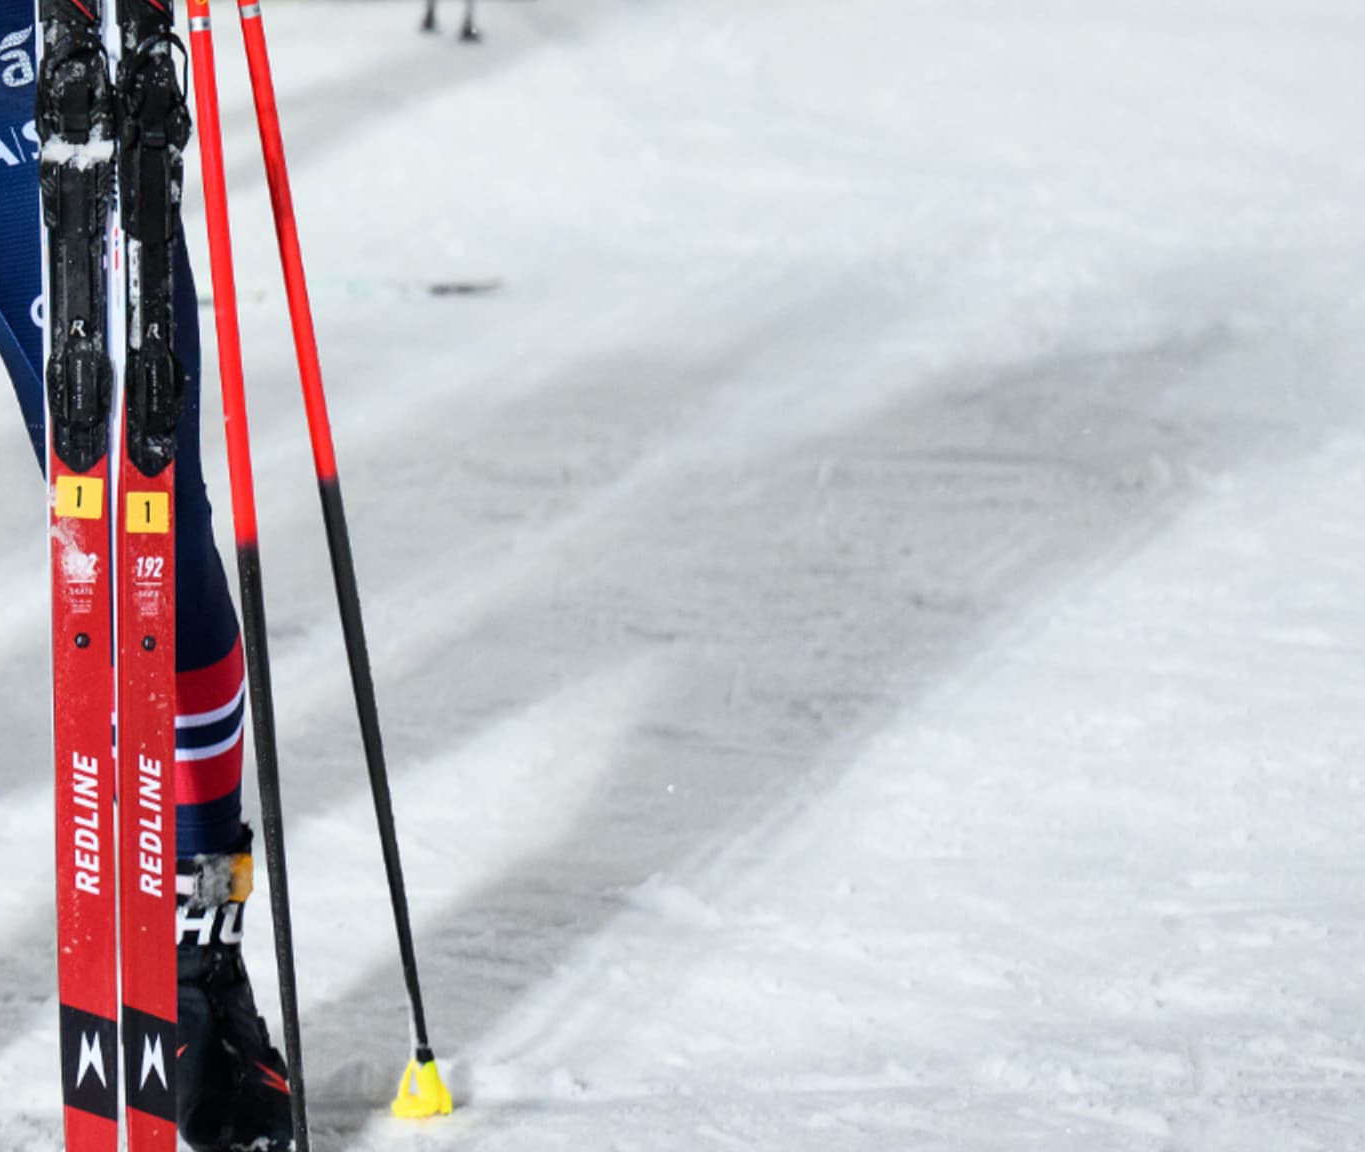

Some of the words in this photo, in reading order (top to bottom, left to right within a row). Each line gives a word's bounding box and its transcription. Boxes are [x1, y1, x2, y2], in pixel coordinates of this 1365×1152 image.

[76, 485, 83, 509] 1
[144, 501, 151, 524] 1
[135, 556, 165, 578] 192
[71, 751, 102, 895] REDLINE
[137, 754, 165, 898] REDLINE
